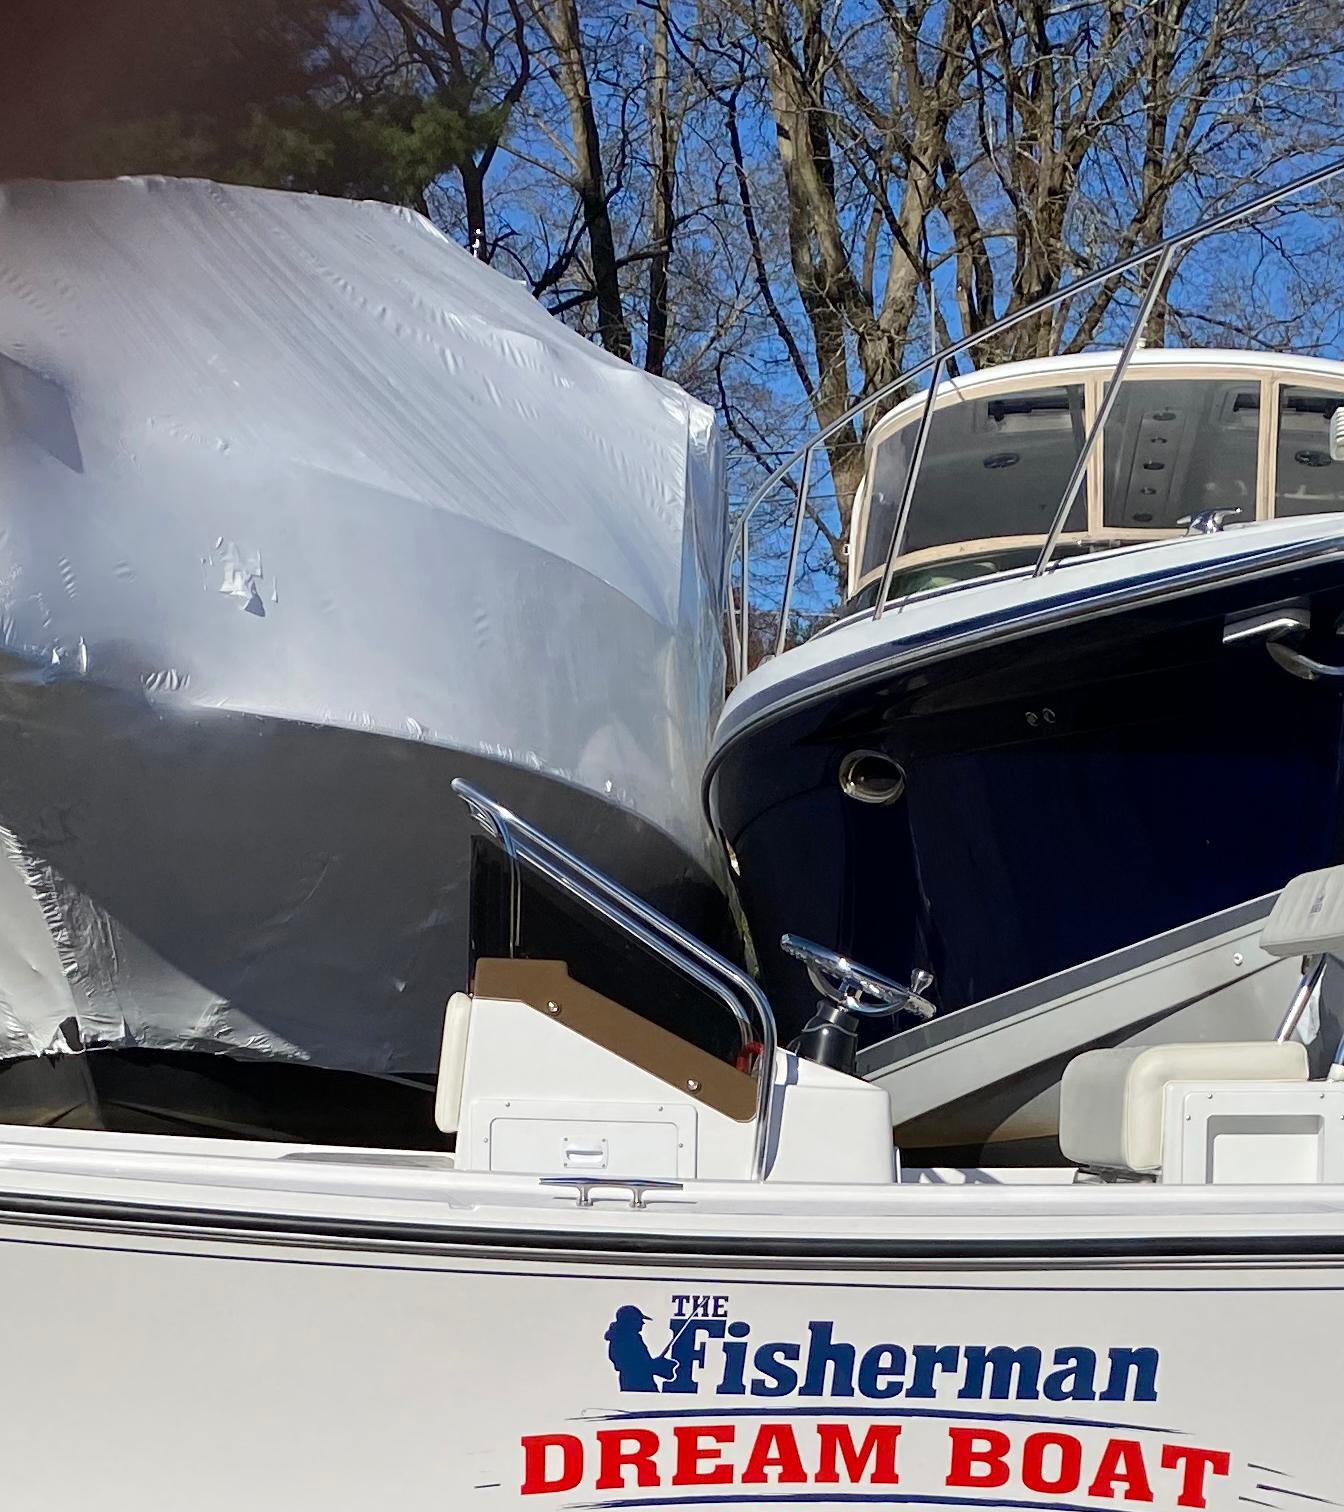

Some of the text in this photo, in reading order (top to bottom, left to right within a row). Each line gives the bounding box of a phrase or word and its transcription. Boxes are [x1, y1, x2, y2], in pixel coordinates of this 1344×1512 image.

[671, 1294, 729, 1318] THE
[665, 1319, 1160, 1402] Fisherman
[520, 1424, 1232, 1509] DREAM BOAT
